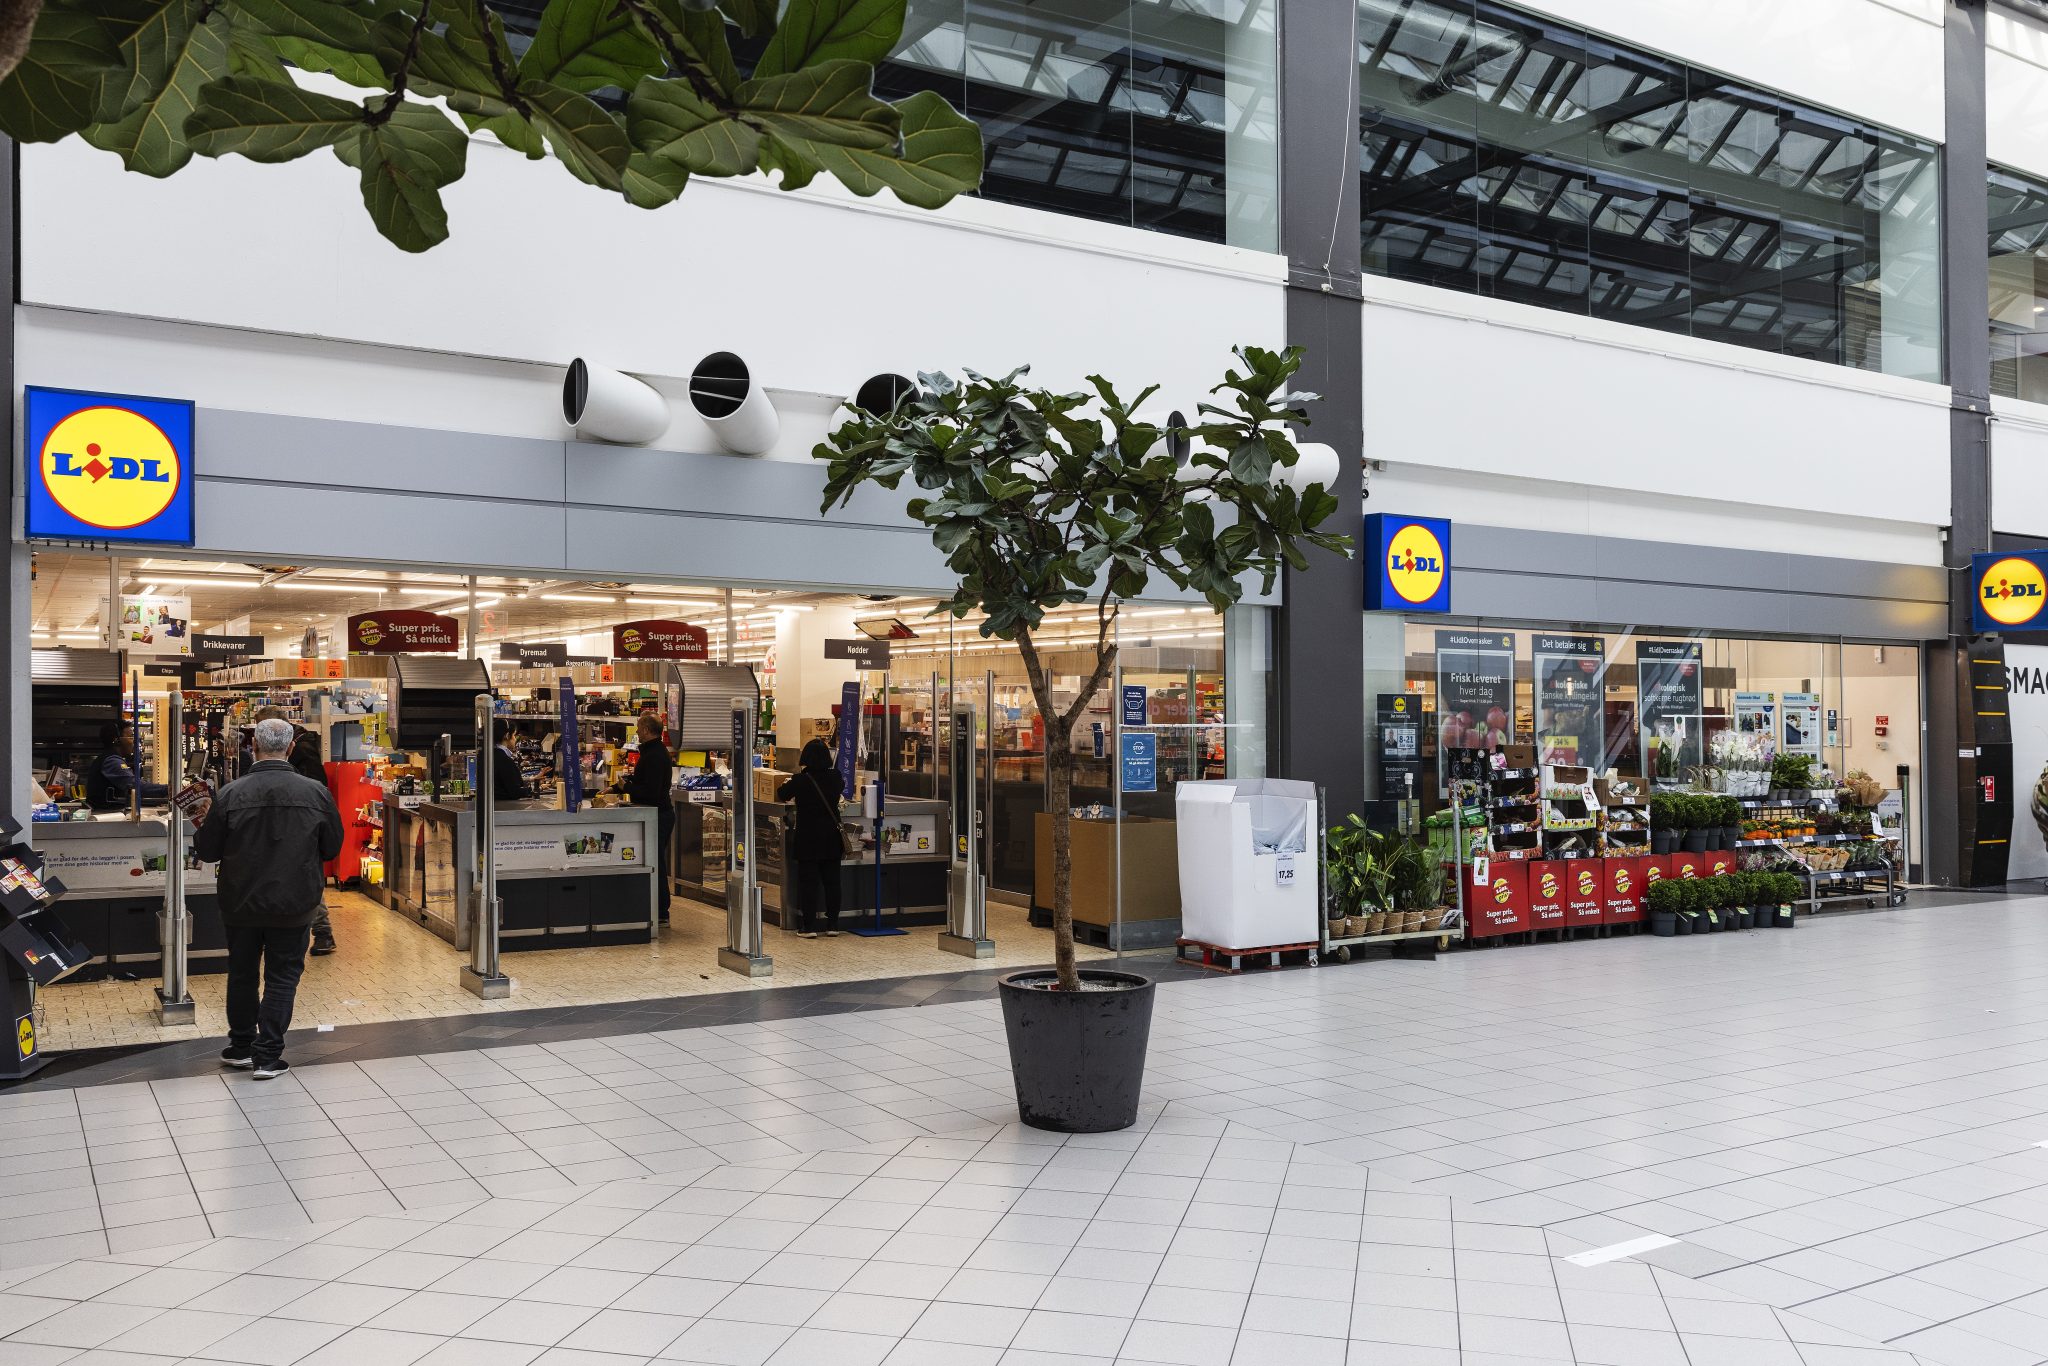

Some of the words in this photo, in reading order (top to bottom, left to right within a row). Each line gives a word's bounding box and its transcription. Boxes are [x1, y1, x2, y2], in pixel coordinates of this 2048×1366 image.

[389, 623, 420, 634] Super
[421, 624, 443, 634] pris.
[406, 634, 418, 644] Så
[420, 635, 452, 644] enkelt
[648, 632, 674, 642] Super
[676, 632, 694, 642] pris.
[203, 640, 246, 650] Drikkevarer
[663, 642, 674, 651] Så
[676, 642, 702, 651] enkelt
[848, 646, 868, 654] Nødder
[1542, 639, 1554, 648] Det
[1555, 640, 1576, 649] betaler
[1578, 641, 1586, 652] sig
[1450, 672, 1471, 682] Frisk
[1472, 673, 1500, 684] leveret
[1460, 685, 1476, 695] hver
[1478, 686, 1493, 698] dag
[1278, 870, 1294, 879] 17,25
[1532, 904, 1548, 912] Super
